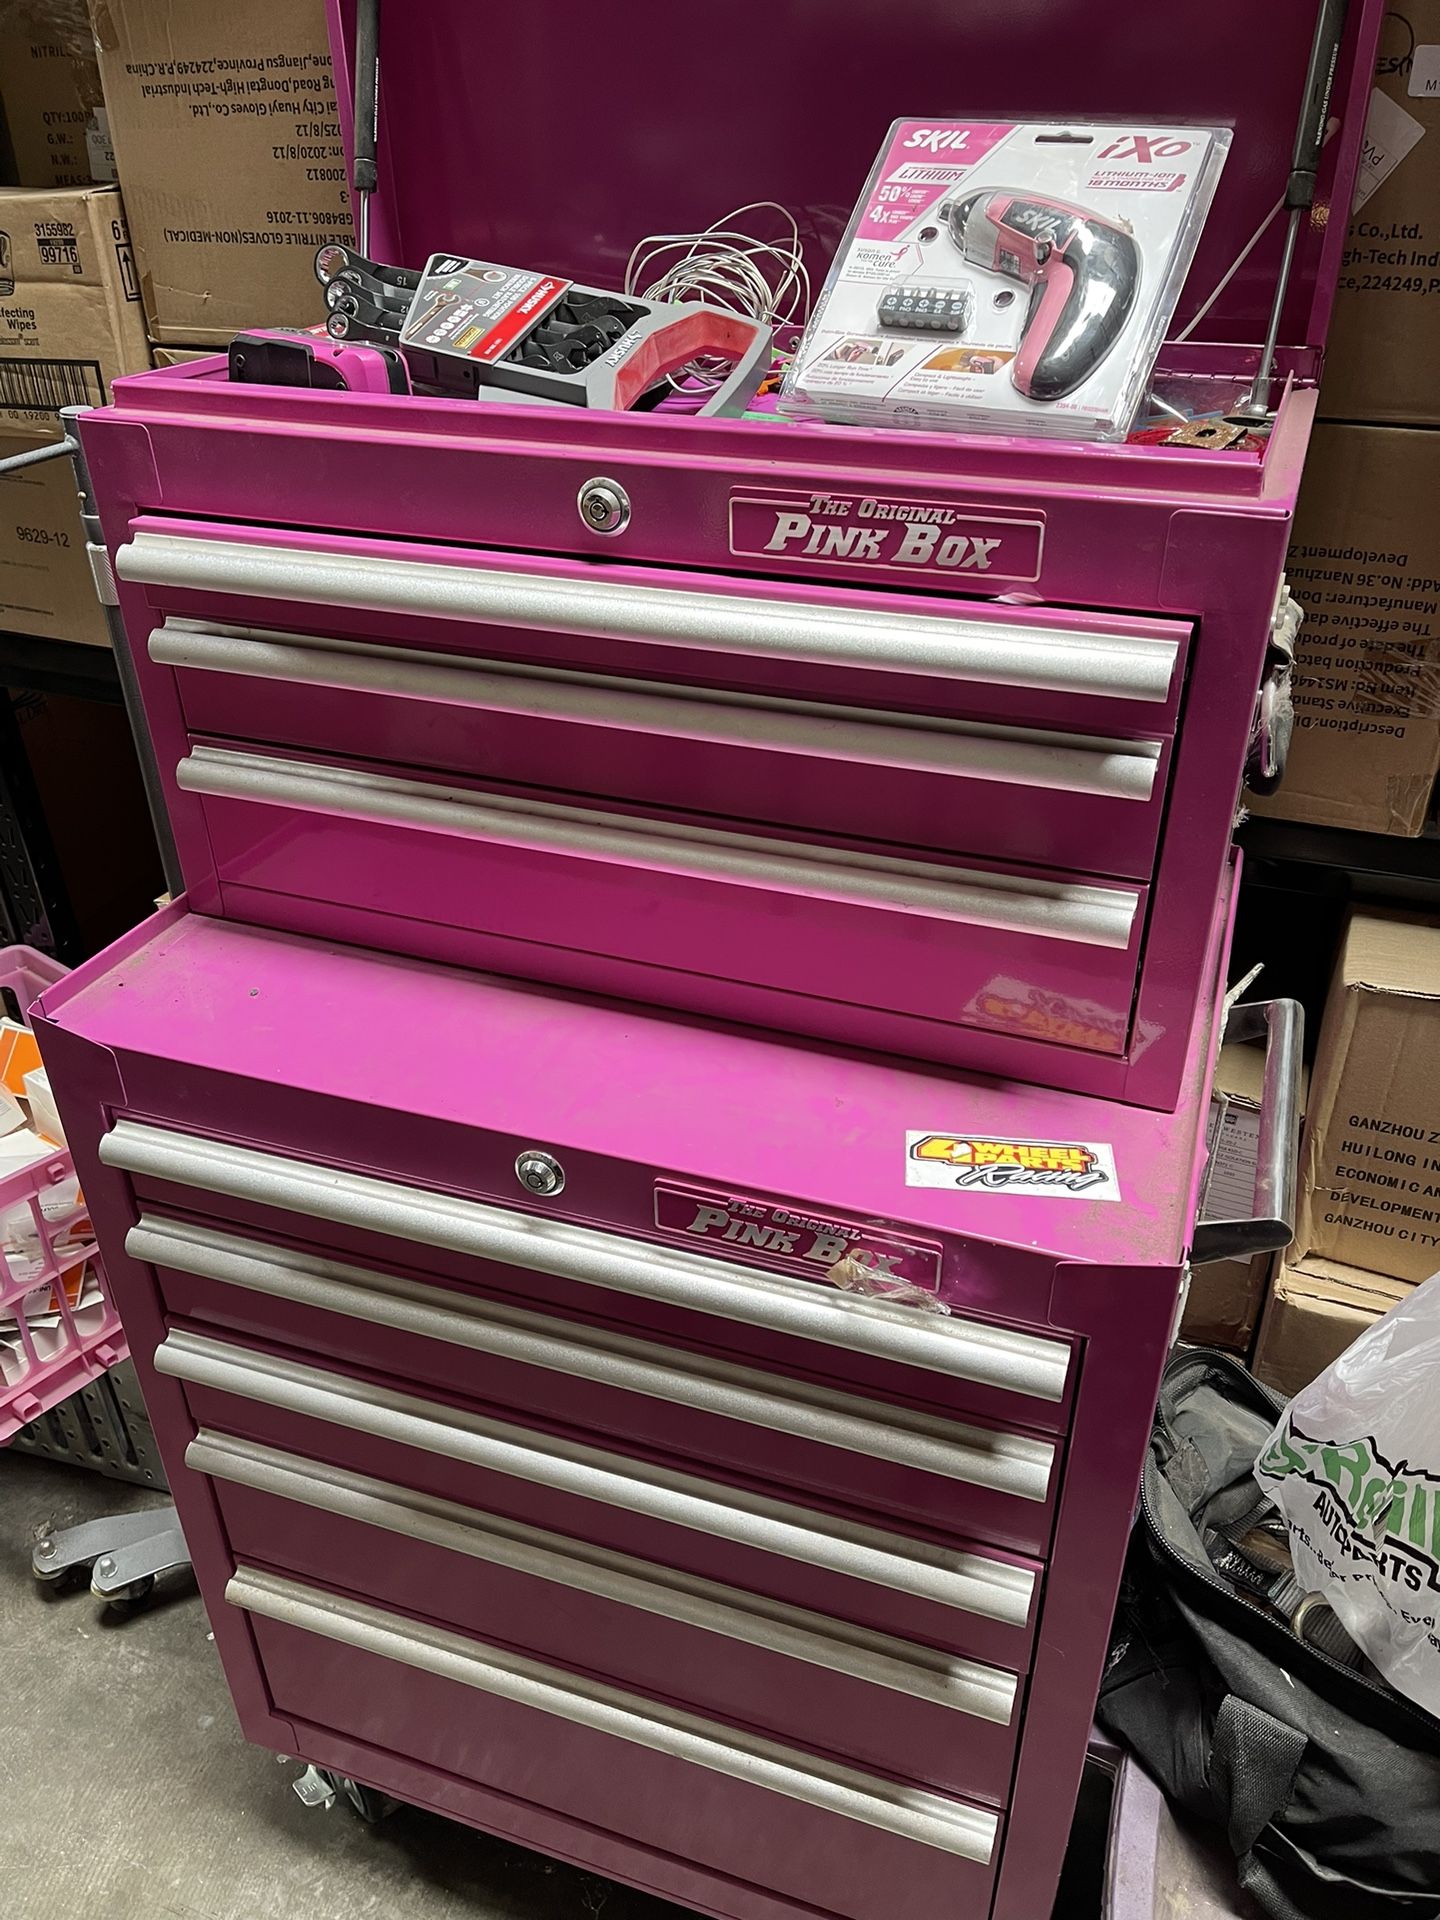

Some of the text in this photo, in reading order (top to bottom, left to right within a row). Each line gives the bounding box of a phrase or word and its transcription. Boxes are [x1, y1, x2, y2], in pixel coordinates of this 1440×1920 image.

[126, 57, 264, 76] Province,224249,P.R.China
[141, 83, 191, 98] Industrial
[192, 79, 244, 97] High-Tech
[246, 76, 320, 95] Road,Dongtai
[189, 101, 230, 118] Co.,Ltd.
[230, 102, 267, 117] Gloves
[268, 100, 300, 117] Huayi
[303, 99, 324, 115] City
[903, 129, 971, 153] SKIL
[273, 145, 326, 160] 2020/8/12
[306, 168, 347, 182] 200812
[898, 168, 966, 181] LITHIUM
[1094, 170, 1176, 180] LITHIUM-ION
[878, 185, 913, 202] 50%
[1098, 180, 1171, 189] MONTHS
[340, 191, 350, 202] -3
[266, 210, 353, 225] GB4806.11-2016
[1015, 209, 1062, 237] SKIL
[34, 222, 75, 237] 3155982
[111, 220, 121, 241] 6
[164, 228, 355, 245] ABLE NITRILE GLOVES(NON-MEDICAL)
[1358, 222, 1424, 242] Co.,Ltd.
[41, 246, 78, 263] 99716
[1342, 248, 1440, 268] gh-Tech Ind
[517, 286, 549, 315] HUSKY
[0, 307, 35, 321] fecting
[6, 319, 37, 332] Wipes
[605, 336, 637, 368] HUSKY
[24, 411, 50, 422] 19200
[808, 493, 958, 525] THE ORIGINAL
[16, 525, 71, 549] 9629-12
[764, 512, 1002, 571] PINK BOX
[1288, 545, 1409, 567] Development Z
[1286, 566, 1440, 593] Add: No.36 Nanzhua
[1326, 591, 1438, 615] Manufacturer:
[1303, 612, 1431, 636] The effective dat
[1340, 637, 1357, 650] of
[1359, 639, 1394, 654] date
[1395, 643, 1426, 657] The
[1335, 658, 1421, 677] Production
[1290, 674, 1348, 691] MS1440
[1291, 695, 1410, 718] Executive Stand
[1293, 715, 1406, 739] Description: DI
[1349, 1115, 1440, 1144] GANZHOU Z
[971, 1141, 1090, 1161] WHEEL
[1341, 1140, 1440, 1172] HUILONG IN
[974, 1152, 1086, 1172] PARTS
[955, 1163, 1109, 1191] Racing
[1335, 1165, 1420, 1193] ECONOMIC
[1330, 1191, 1440, 1224] DEVELOPMENT
[686, 1203, 800, 1254] PINK
[727, 1197, 863, 1241] THE ORIGINAL
[1324, 1213, 1440, 1248] GANZHOU CITY
[1312, 1490, 1351, 1546] AUTO
